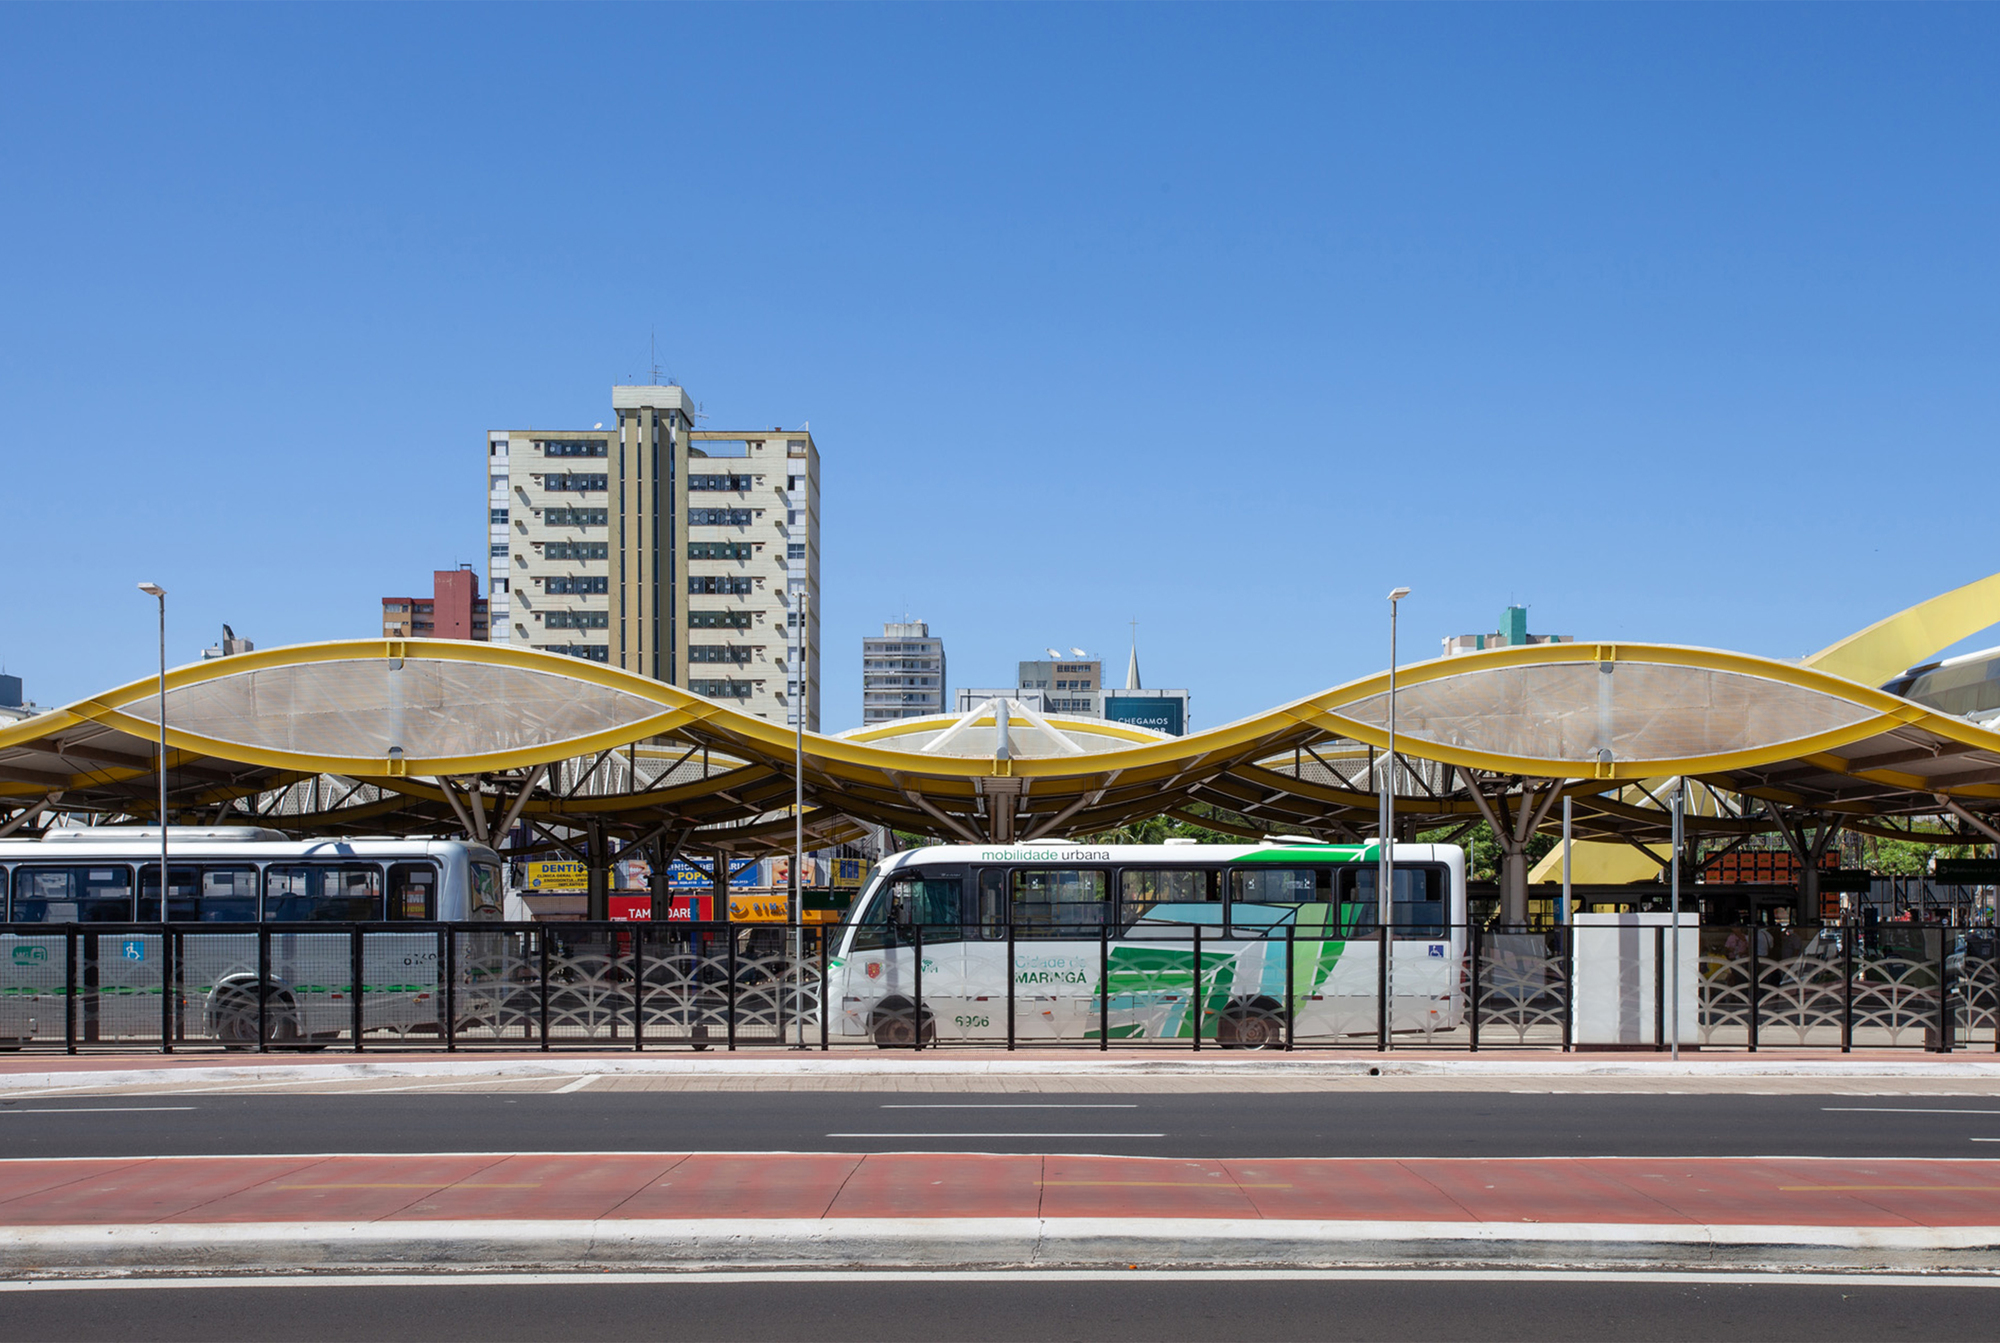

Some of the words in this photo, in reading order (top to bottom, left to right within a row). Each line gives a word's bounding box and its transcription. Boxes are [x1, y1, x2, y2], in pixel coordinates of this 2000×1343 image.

[1118, 717, 1169, 725] CHEGAMOS
[982, 849, 1059, 861] mobilidade
[1061, 849, 1110, 861] urbana
[541, 864, 585, 873] DENTIS
